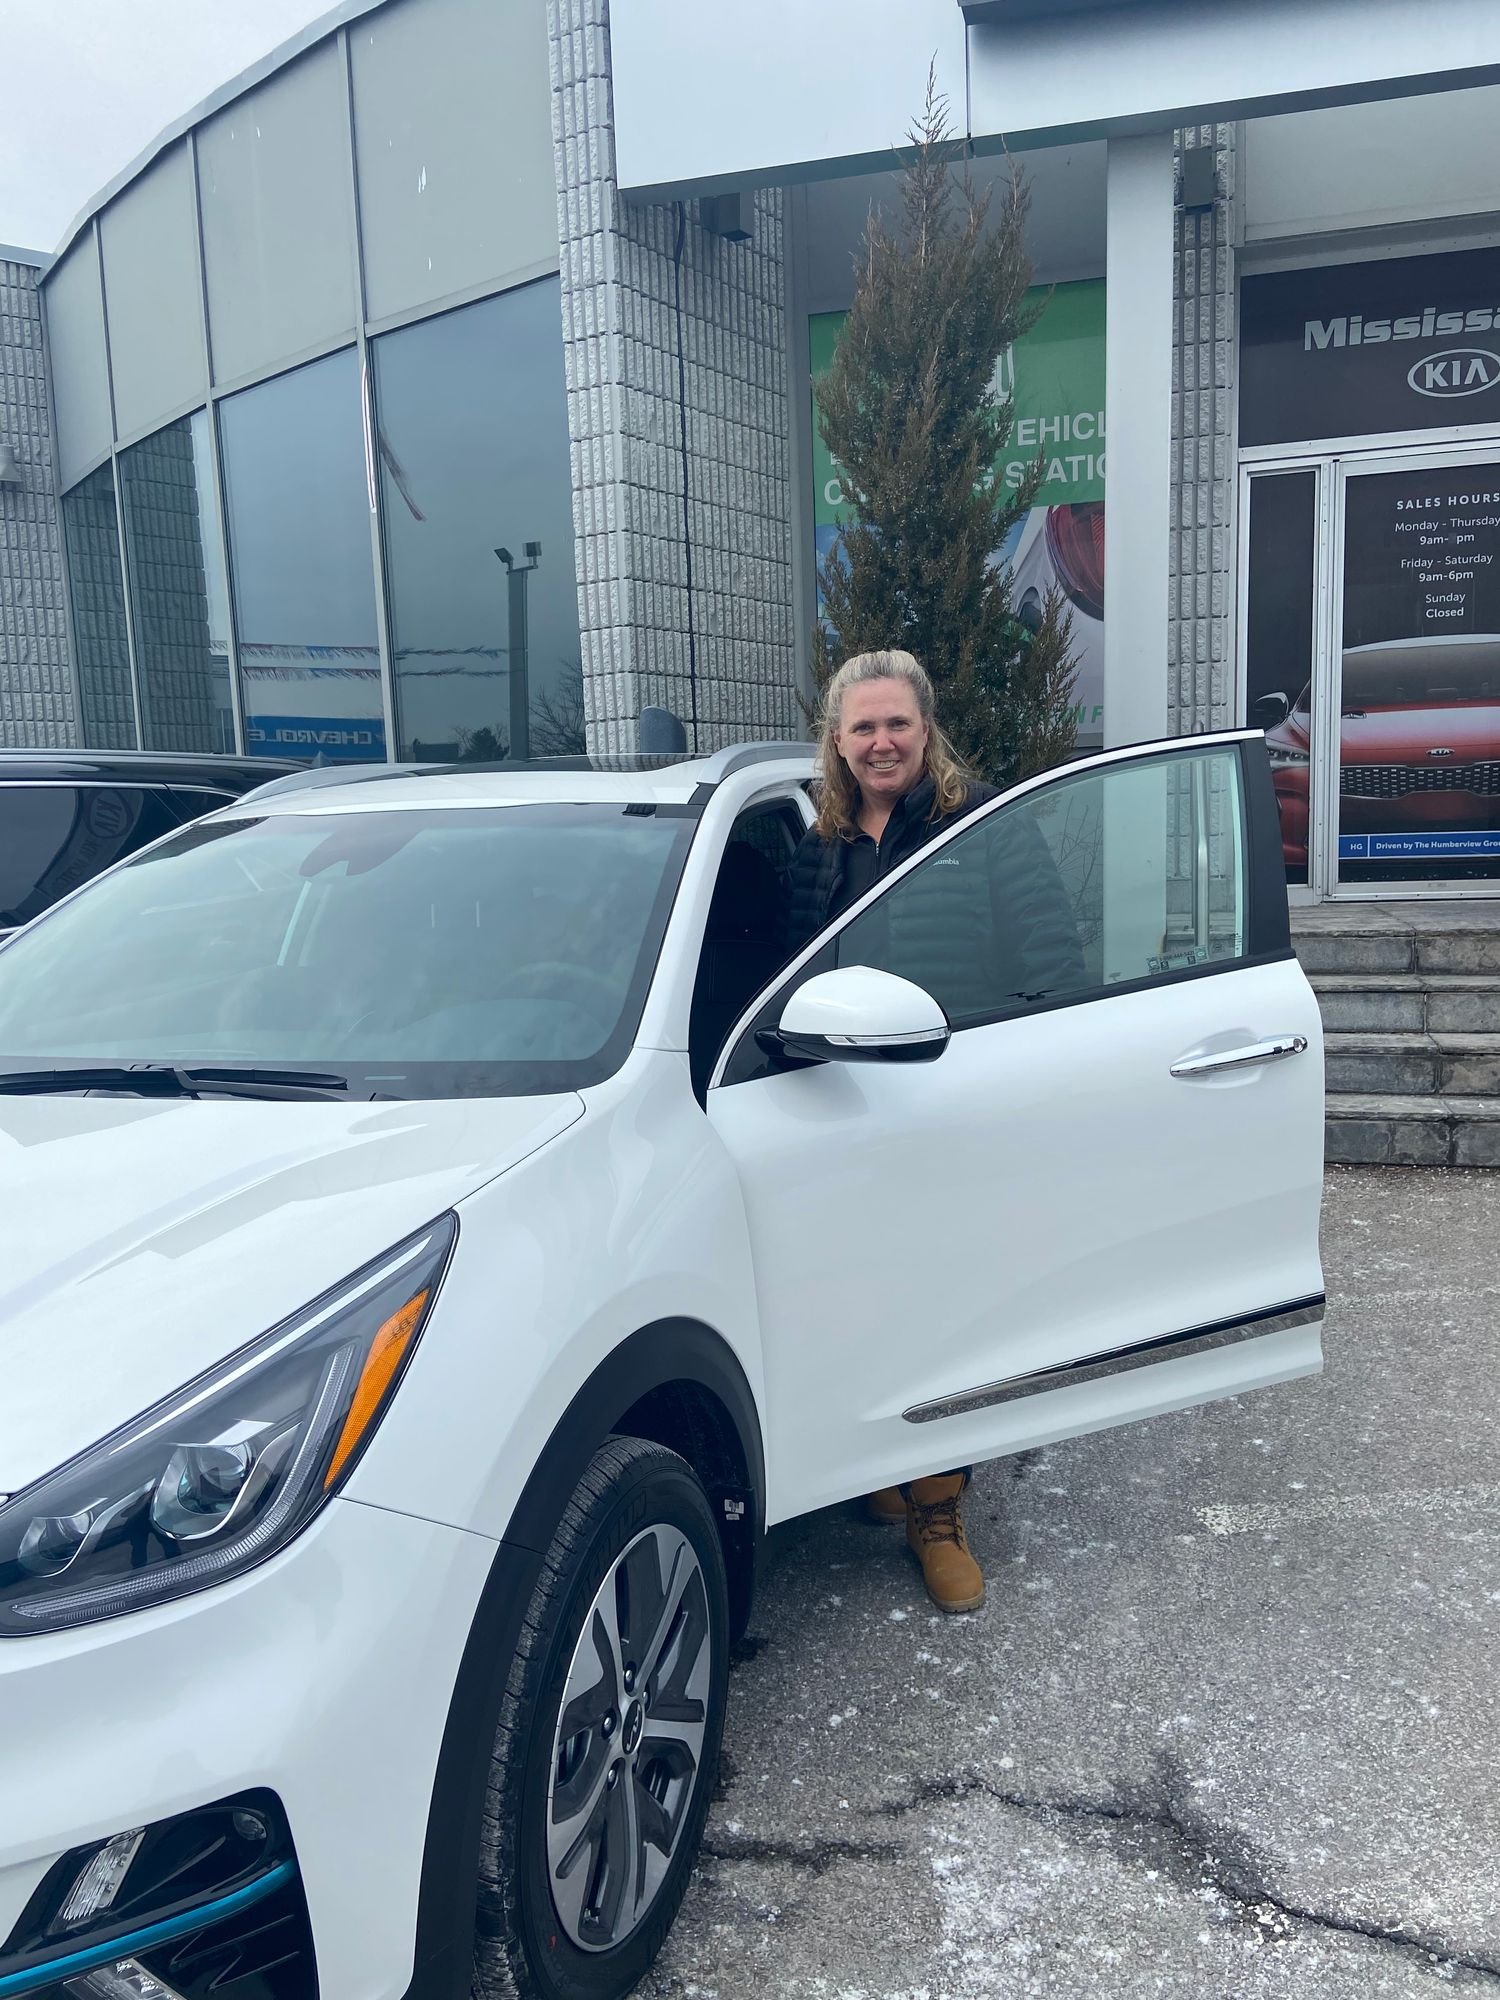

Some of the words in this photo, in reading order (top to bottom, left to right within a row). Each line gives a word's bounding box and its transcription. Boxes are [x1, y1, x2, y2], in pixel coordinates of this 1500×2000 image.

[1304, 307, 1500, 351] Mississ
[1425, 358, 1489, 389] KIA
[997, 411, 1106, 448] EHICL
[1396, 497, 1441, 510] SALES
[1448, 492, 1500, 506] HOURS
[1395, 520, 1439, 532] Monday
[1450, 515, 1500, 528] Thursday
[1401, 558, 1434, 569] Friday
[1445, 553, 1493, 565] Saturday
[1419, 570, 1474, 582] 9am-6pm
[1425, 592, 1466, 604] Sunday
[1426, 606, 1464, 618] Closed
[1376, 841, 1402, 850] Driven
[1403, 841, 1413, 851] by
[1414, 841, 1430, 849] The
[1431, 839, 1482, 849] Humberview
